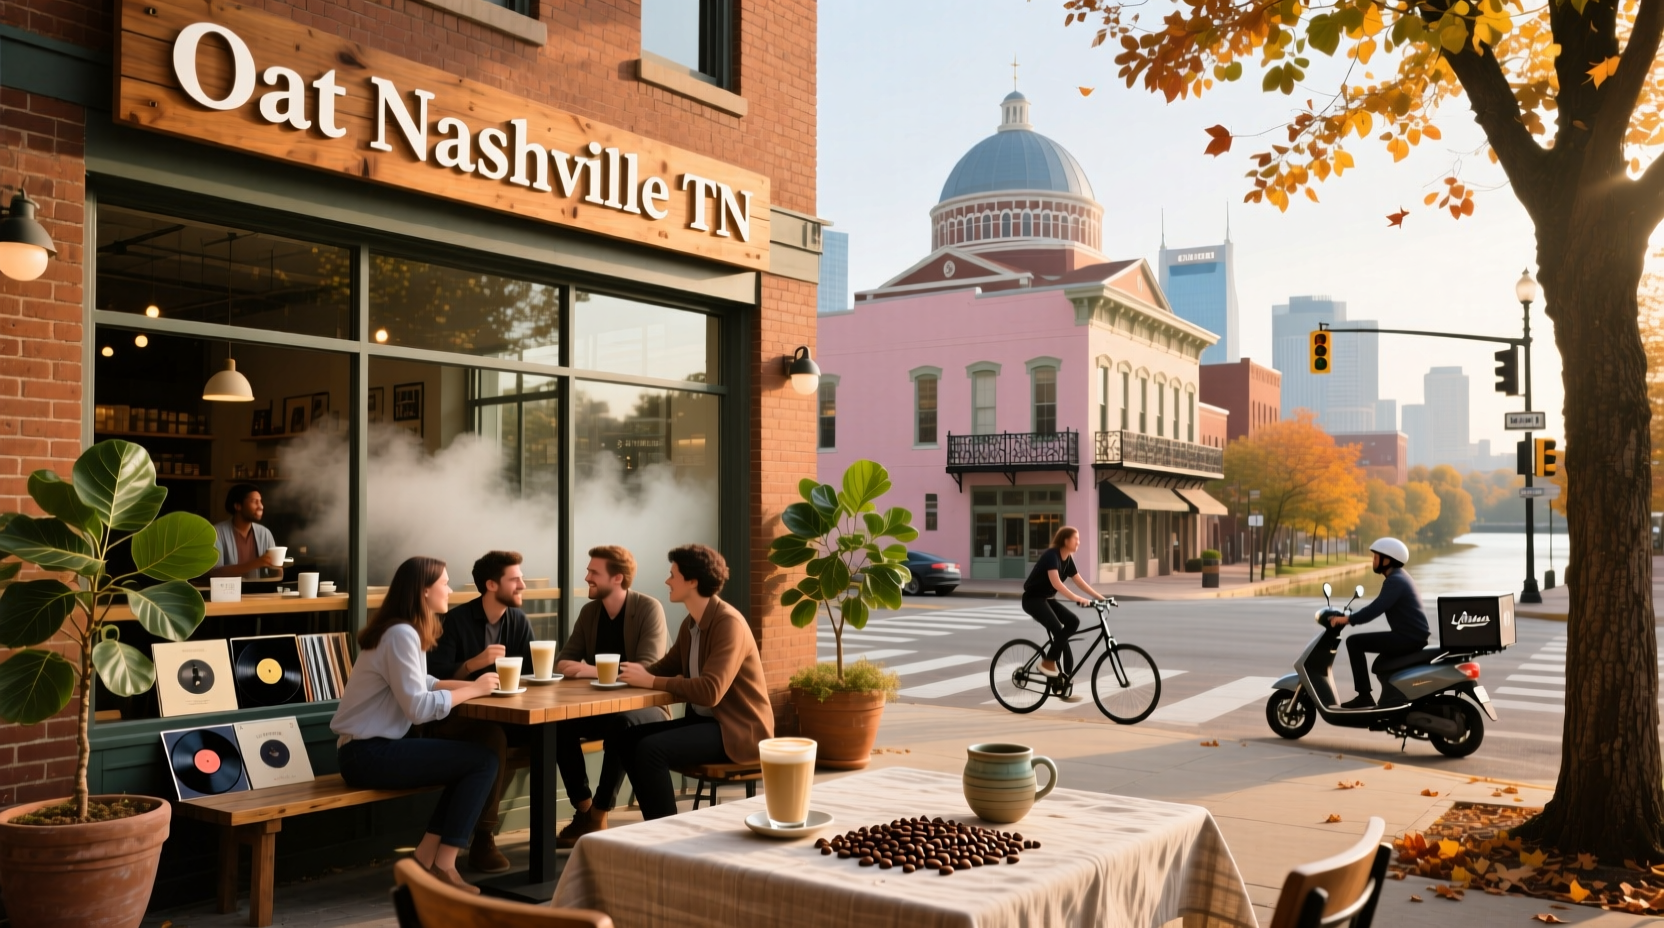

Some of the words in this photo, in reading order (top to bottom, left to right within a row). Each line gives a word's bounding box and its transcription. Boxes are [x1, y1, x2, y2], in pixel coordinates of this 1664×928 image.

[172, 22, 347, 138] Oat
[369, 76, 670, 221] Nashville
[682, 172, 754, 243] TN
